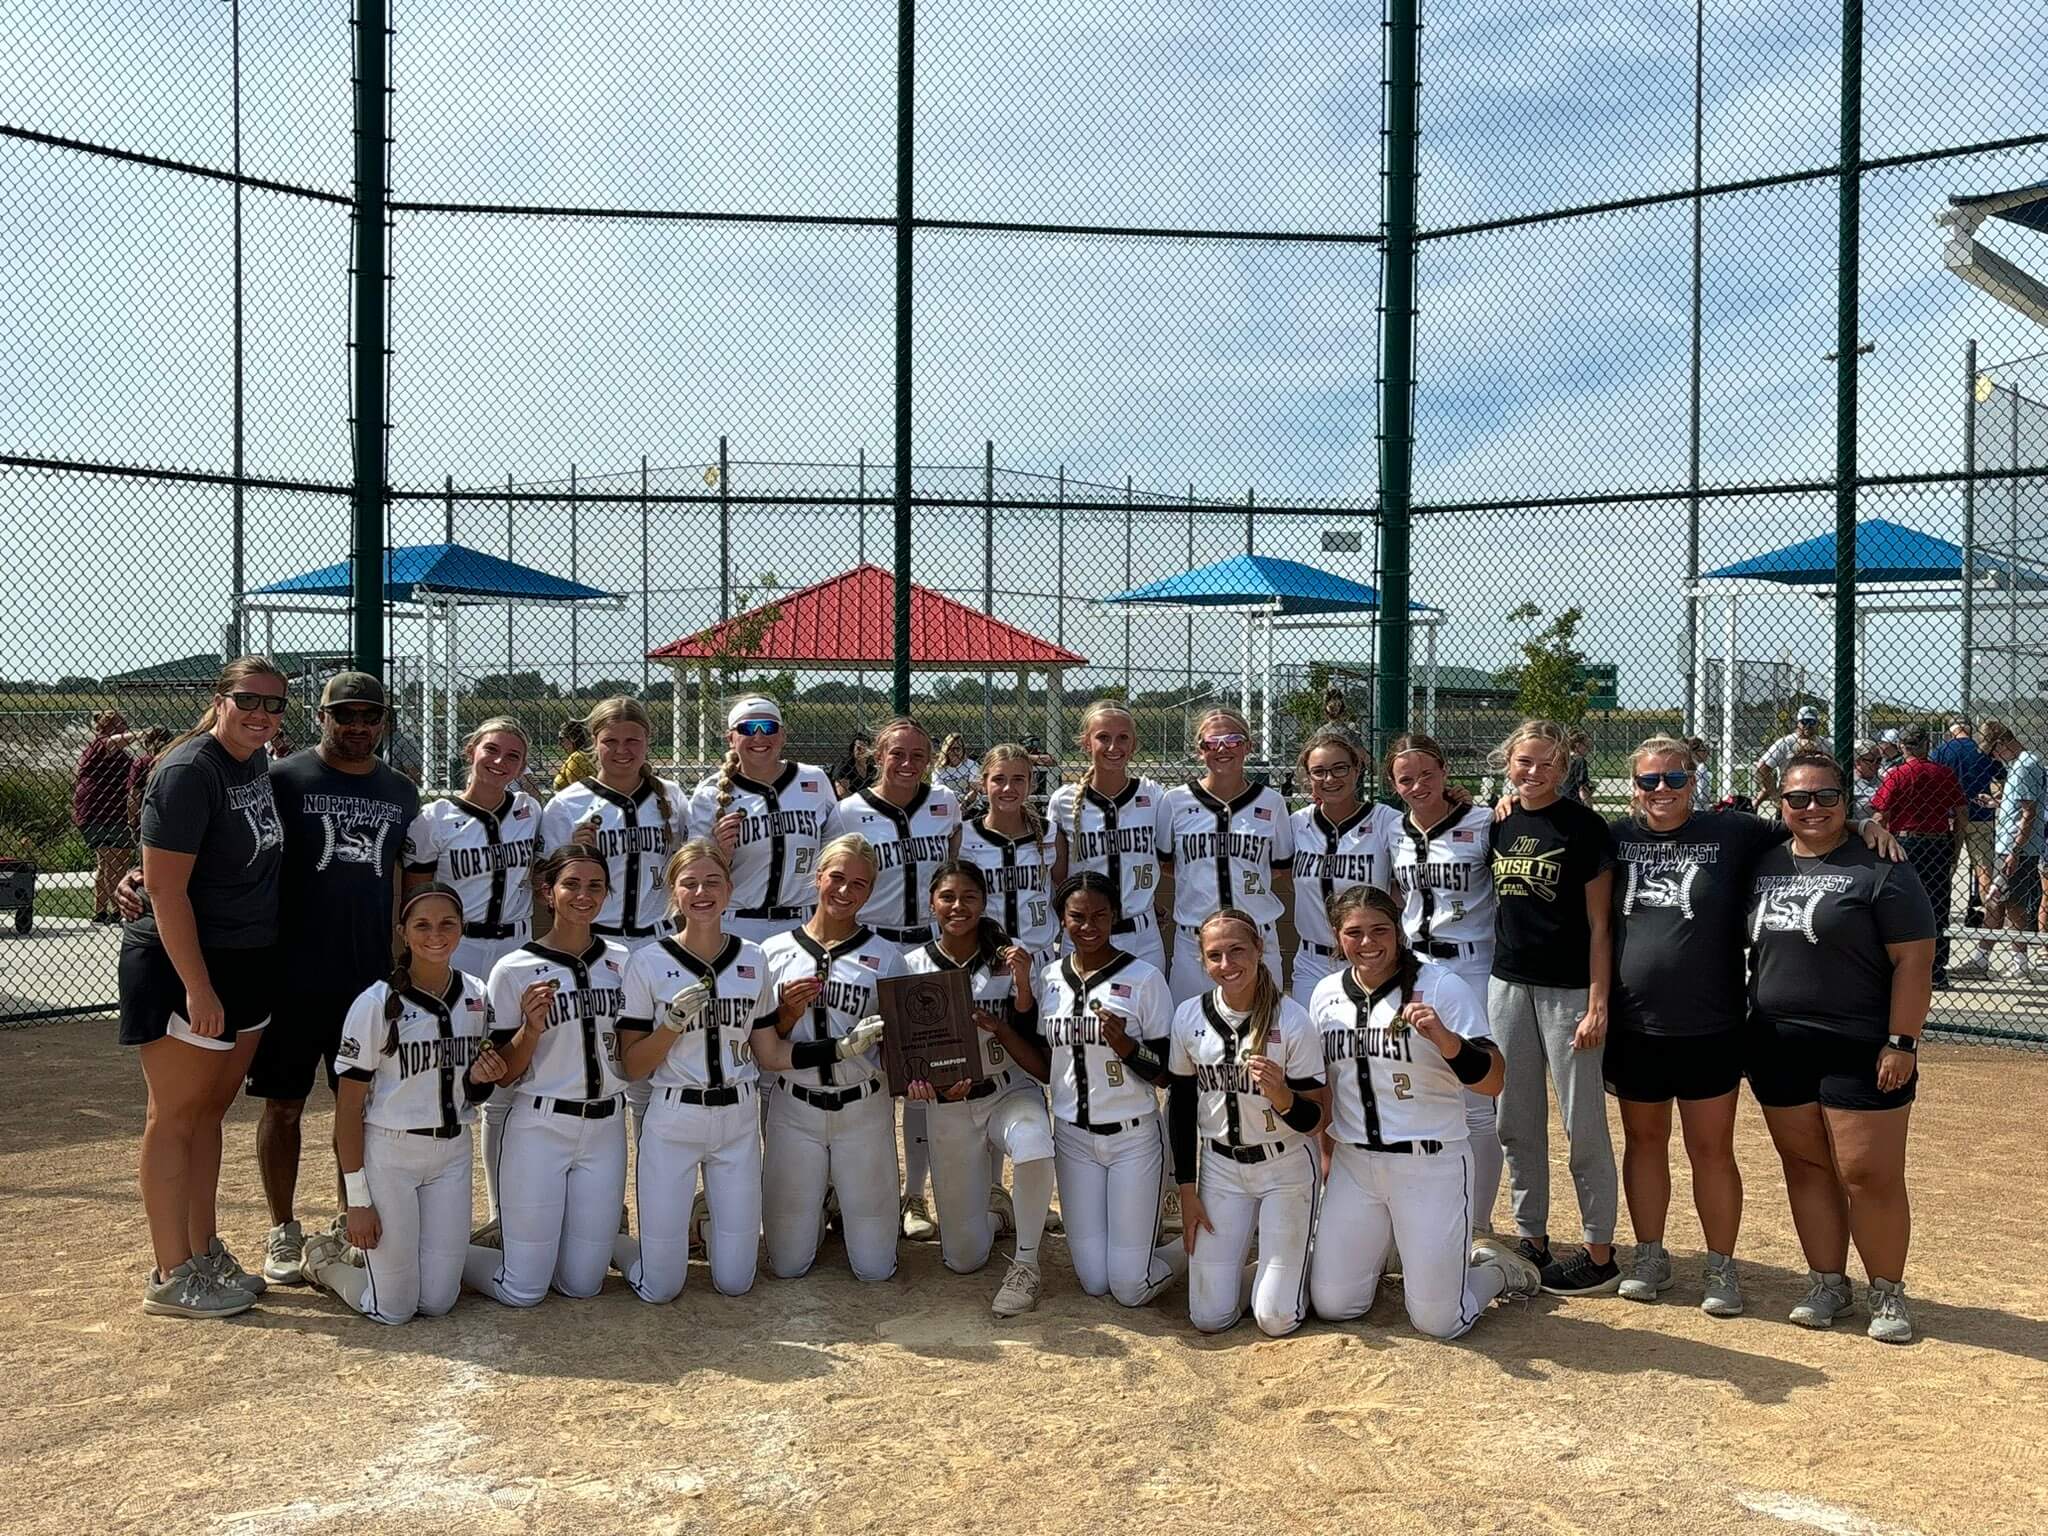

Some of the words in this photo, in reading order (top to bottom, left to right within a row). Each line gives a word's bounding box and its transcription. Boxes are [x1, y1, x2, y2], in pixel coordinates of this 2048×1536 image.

[303, 793, 402, 825] NORTHWEST
[1077, 826, 1154, 862] ORTHWEST
[1182, 832, 1268, 865] NORTHWEST
[1617, 841, 1720, 864] NORTHWEST
[1132, 864, 1154, 890] 16
[1536, 861, 1556, 879] IT
[1754, 874, 1853, 894] NORTHWEST
[1027, 901, 1047, 928] 15
[986, 1037, 1005, 1066] 6
[1323, 1027, 1413, 1066] NORTHWEST
[930, 1057, 967, 1068] CHAMPION
[1105, 1060, 1124, 1088] 9
[1392, 1072, 1414, 1101] 2
[1262, 1108, 1277, 1132] 1
